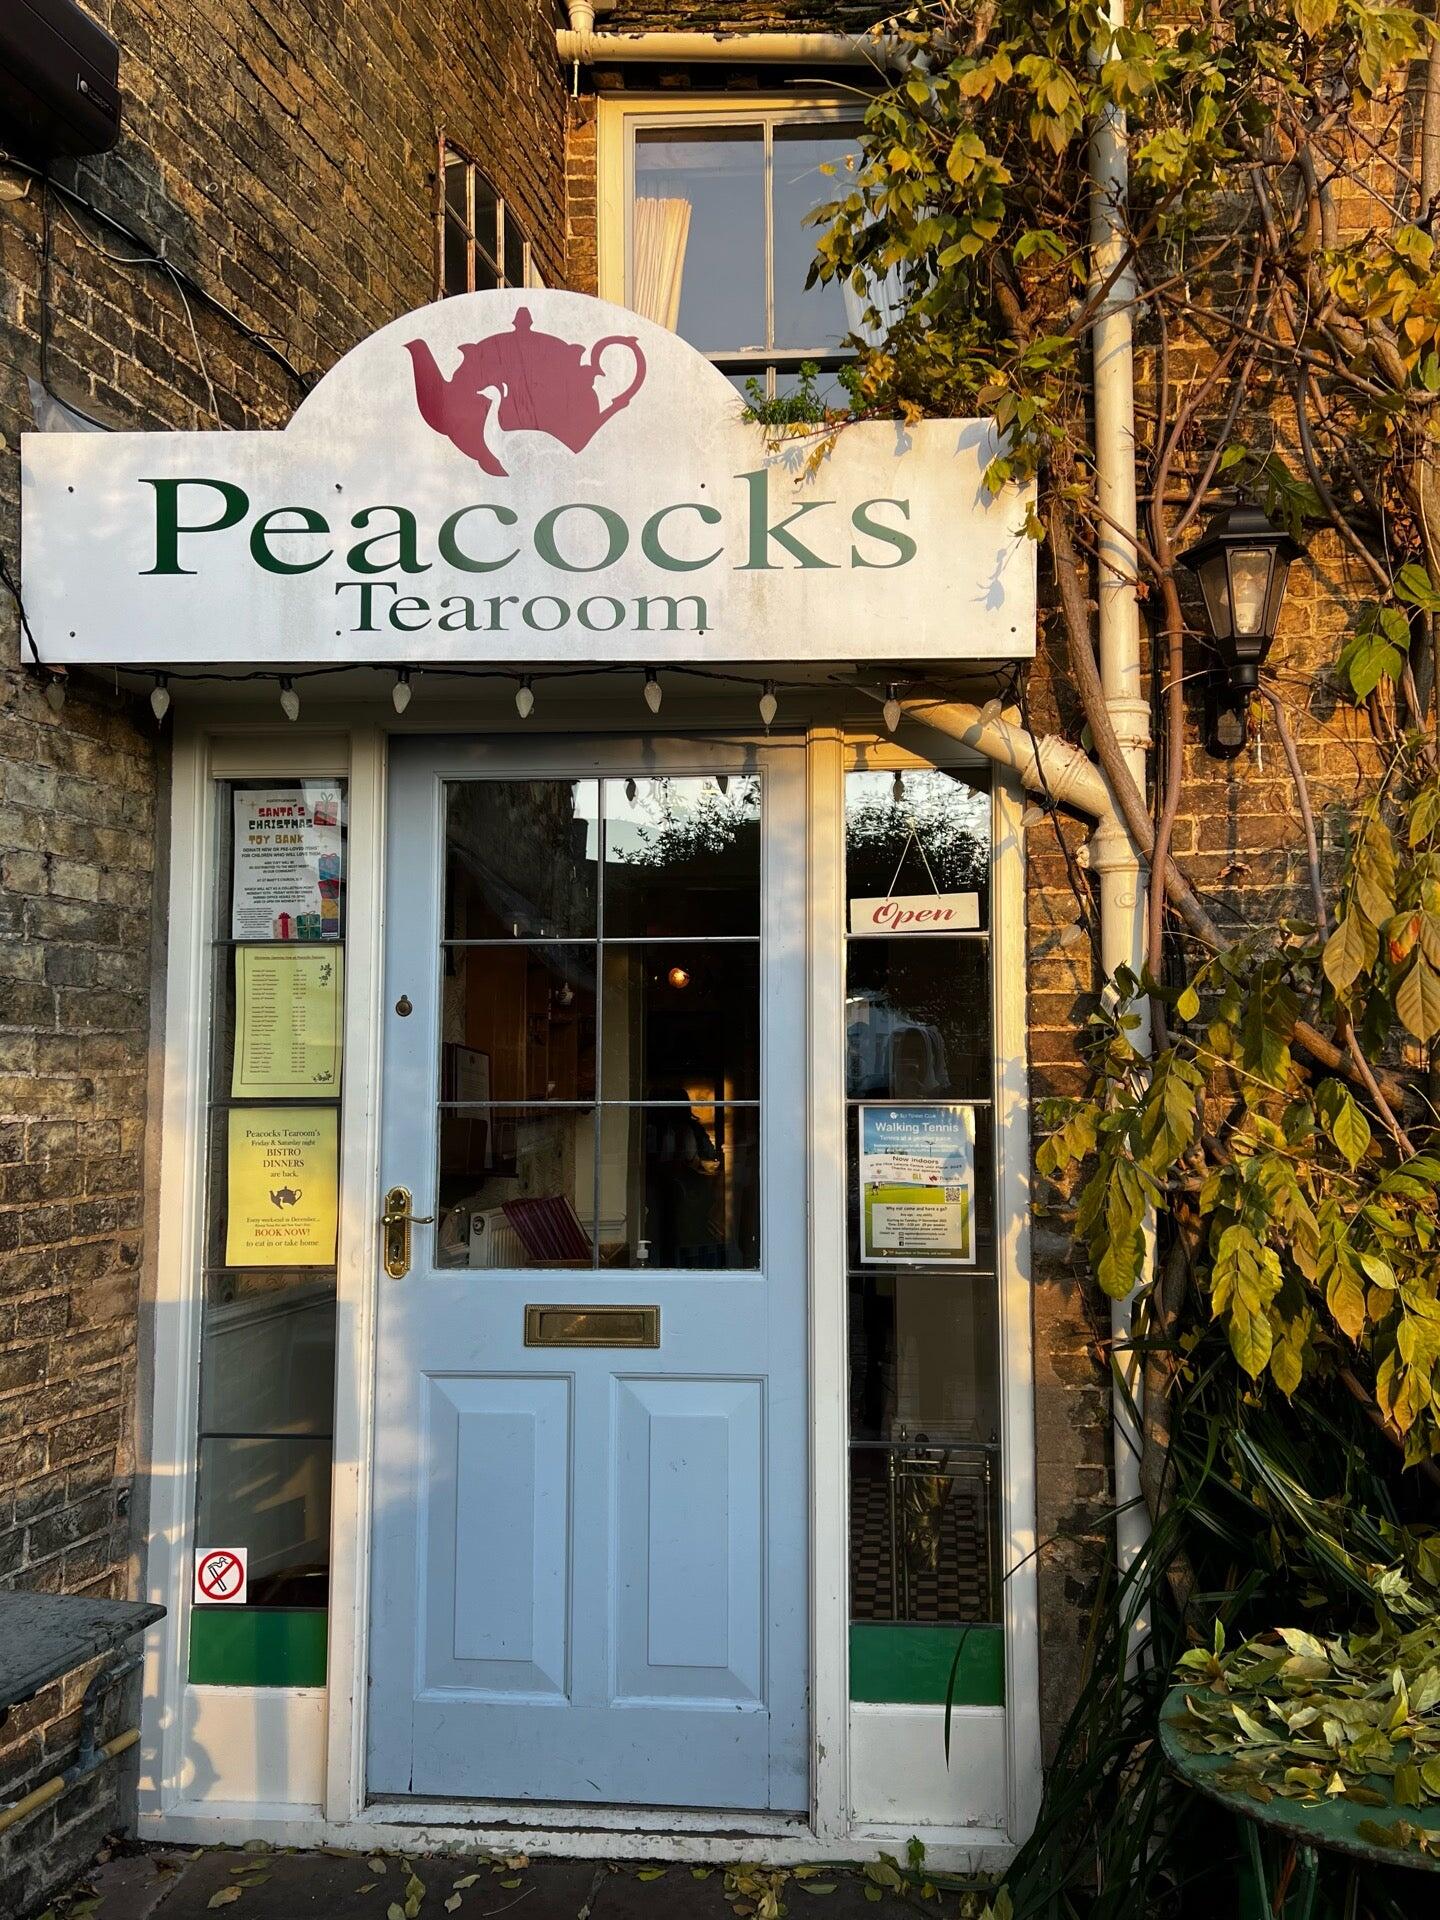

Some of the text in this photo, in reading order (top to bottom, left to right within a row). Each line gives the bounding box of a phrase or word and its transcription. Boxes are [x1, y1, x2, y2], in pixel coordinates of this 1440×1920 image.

[138, 469, 917, 575] Peacocks
[335, 581, 713, 631] Tearoom
[249, 818, 313, 830] CHRISTMAS
[248, 833, 304, 845] TOY BANK
[872, 902, 957, 930] Open
[875, 1121, 960, 1135] Walking Tennis
[246, 1129, 321, 1138] Peacocks Tearoom's
[879, 1134, 900, 1142] Tennis
[251, 1139, 269, 1147] Friday
[277, 1139, 301, 1147] Saturday
[302, 1139, 316, 1147] night
[266, 1148, 302, 1157] BISTRO
[263, 1159, 305, 1168] DINNERS
[911, 1156, 939, 1165] indoors
[255, 1227, 310, 1237] BOOK NOW!
[246, 1240, 254, 1248] to
[266, 1239, 274, 1247] in
[284, 1239, 299, 1247] take
[299, 1239, 320, 1247] home
